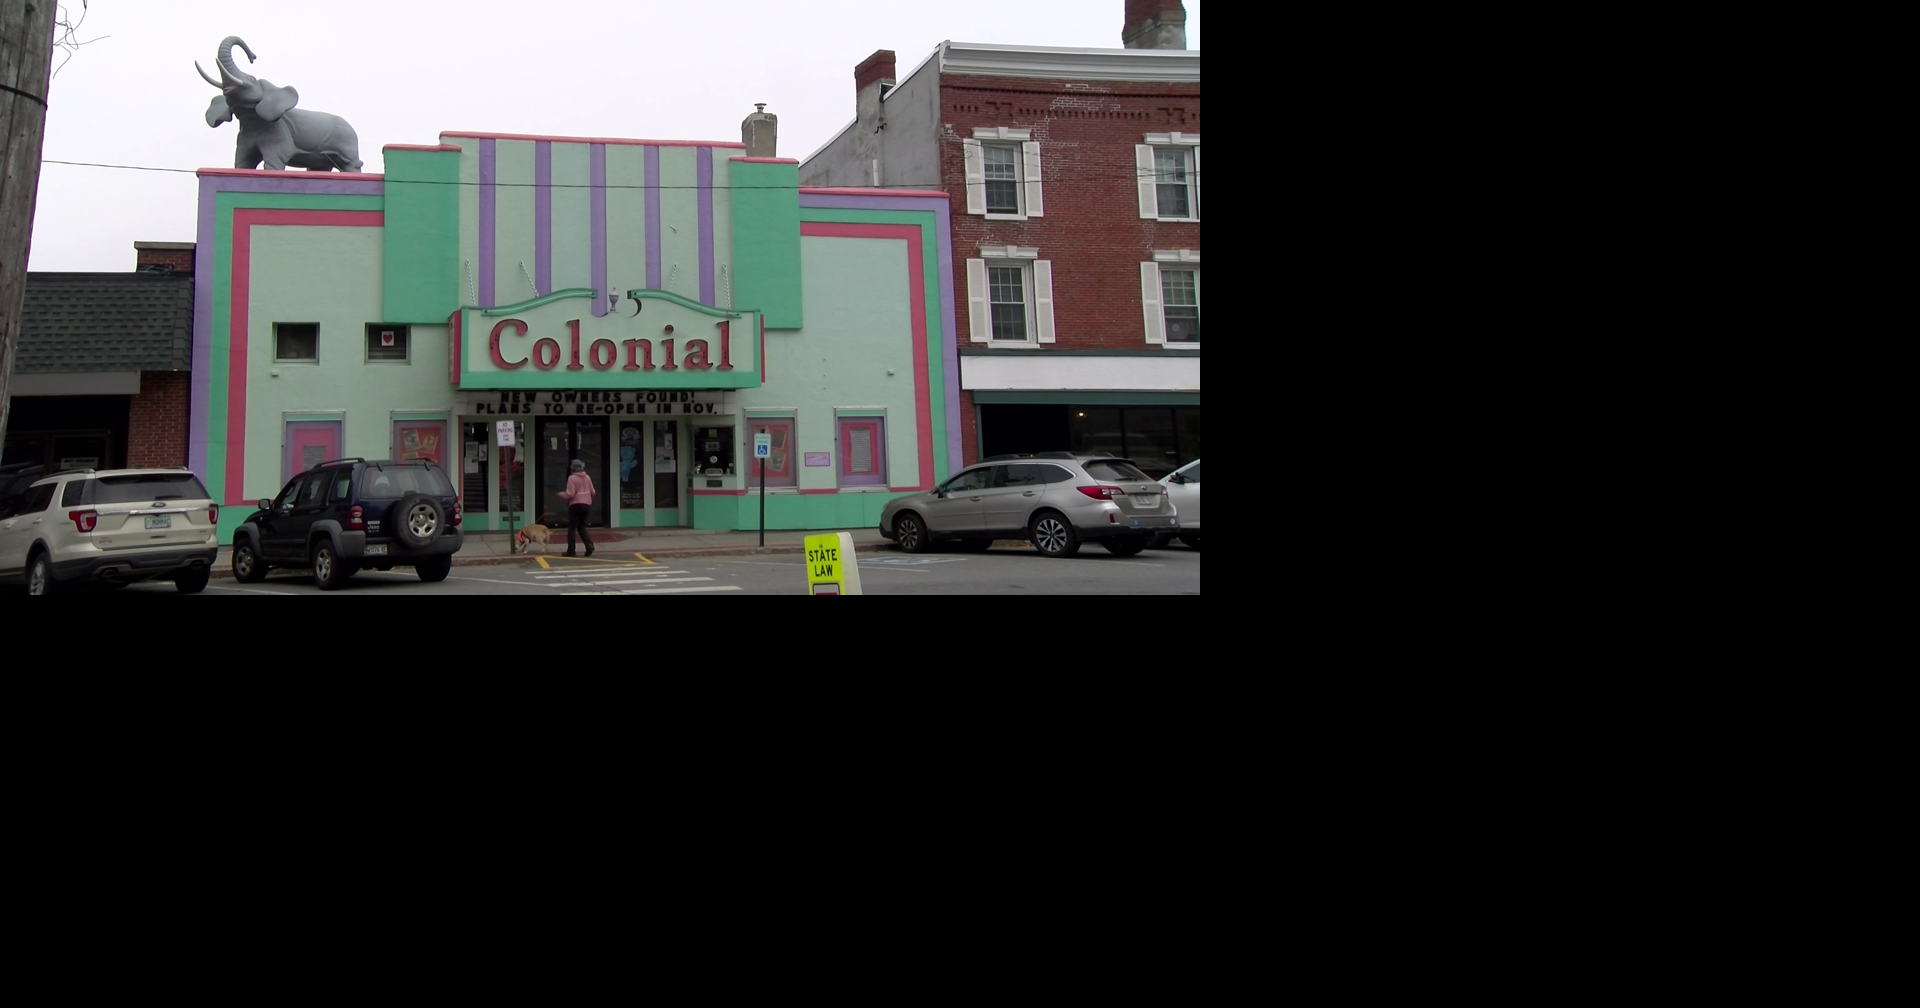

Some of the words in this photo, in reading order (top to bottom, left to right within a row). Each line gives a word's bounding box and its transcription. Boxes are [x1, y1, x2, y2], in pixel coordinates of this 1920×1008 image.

[489, 318, 734, 371] Colonial
[500, 391, 537, 404] NEW
[552, 391, 622, 403] OWNERS
[636, 391, 696, 403] FOUND!
[476, 403, 532, 414] PLANS
[544, 403, 564, 414] TO
[576, 403, 646, 414] RE-OPEN
[657, 403, 672, 414] IN
[683, 402, 718, 415] NOV.
[808, 549, 837, 562] STATE
[814, 564, 833, 577] LAW
